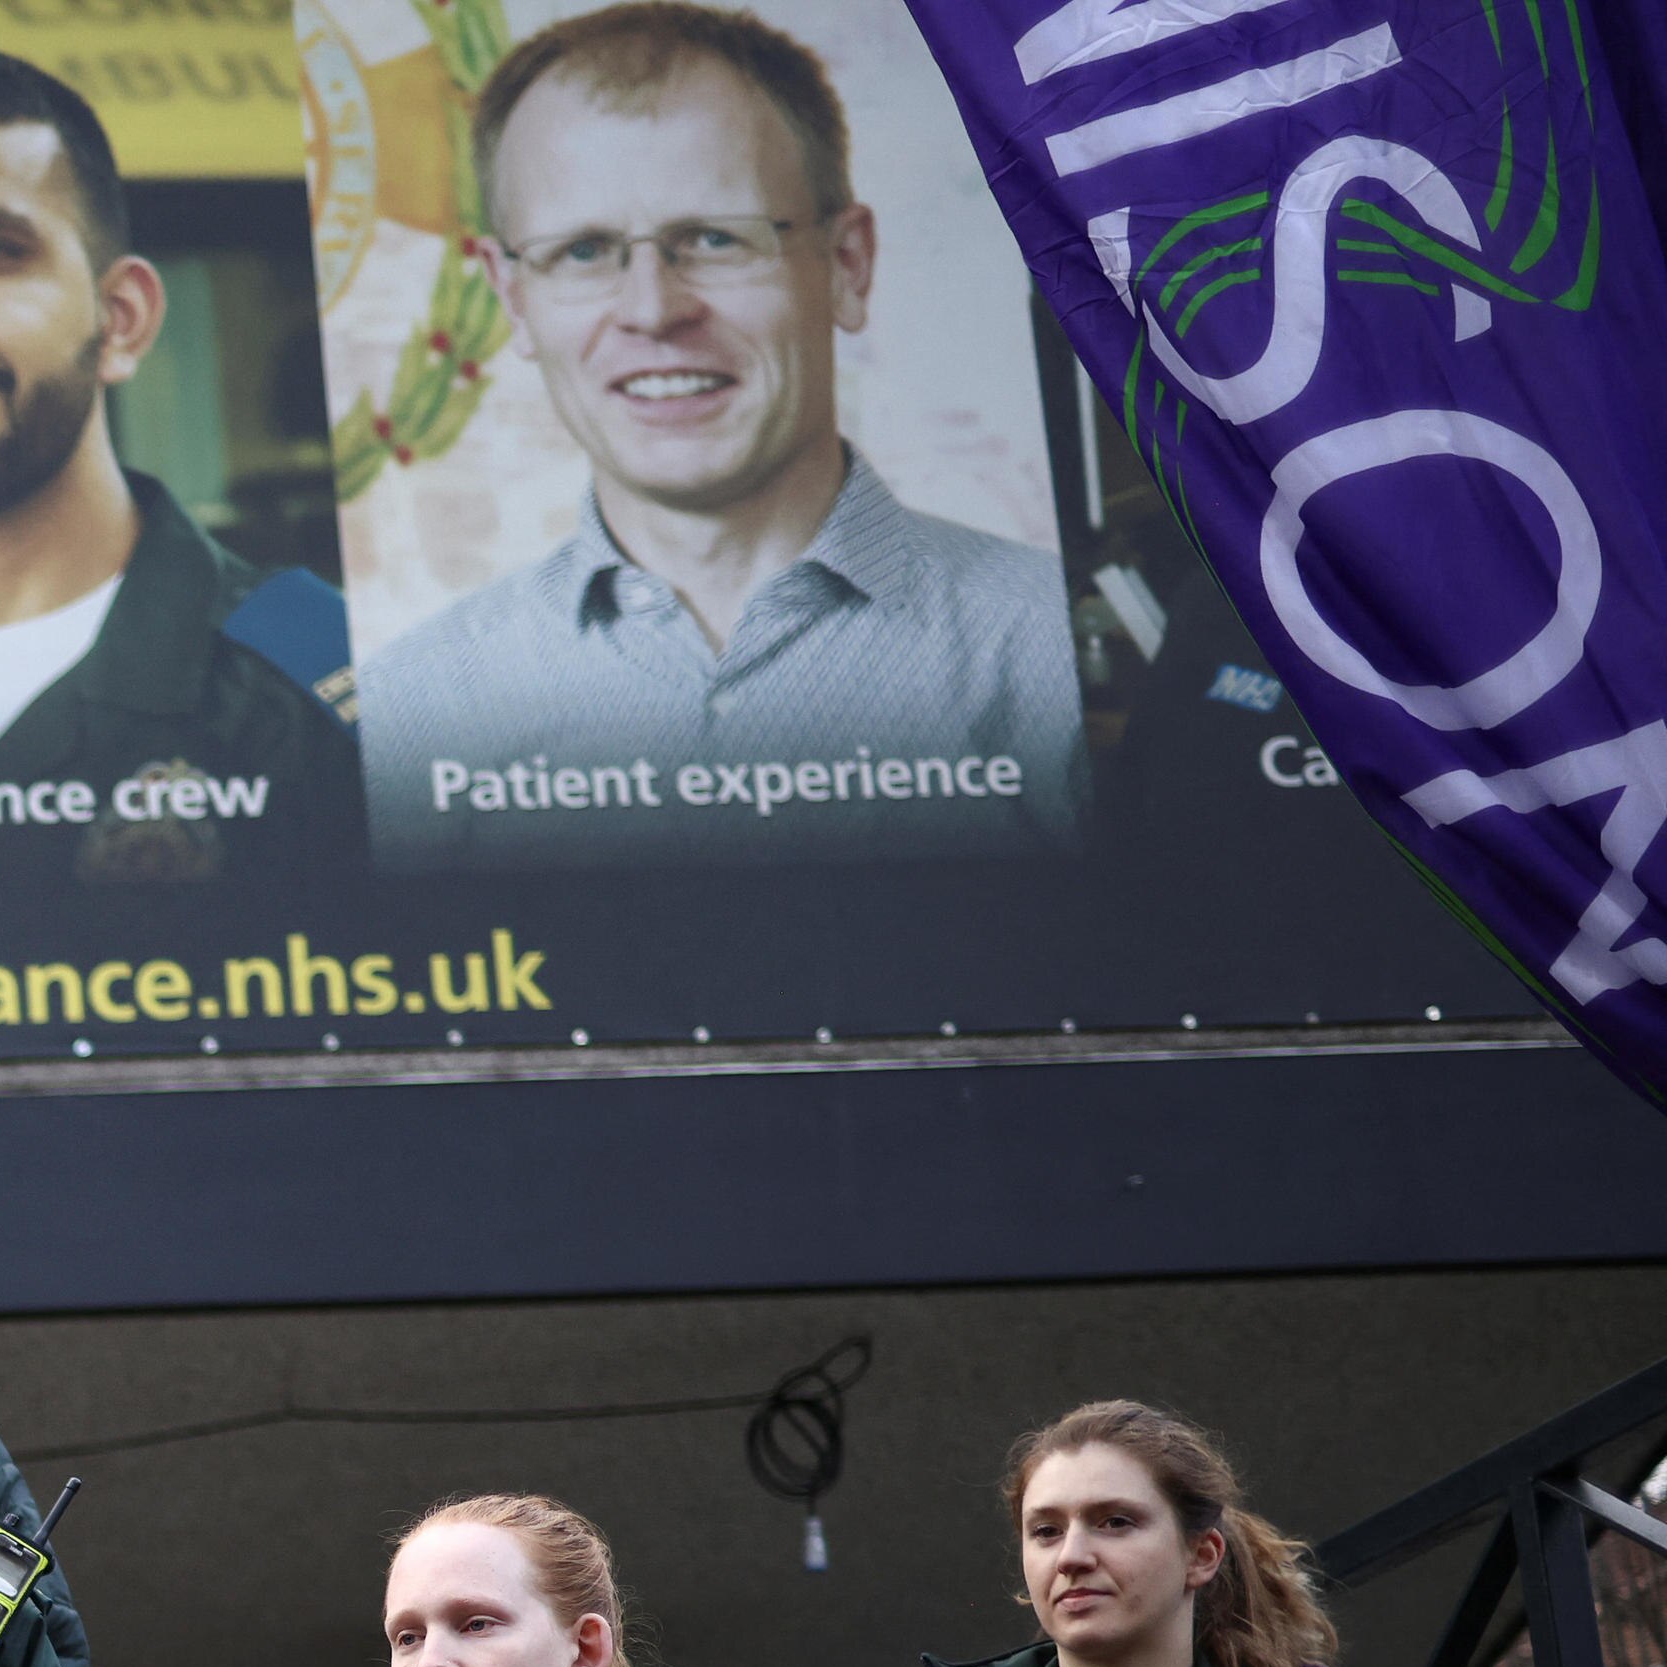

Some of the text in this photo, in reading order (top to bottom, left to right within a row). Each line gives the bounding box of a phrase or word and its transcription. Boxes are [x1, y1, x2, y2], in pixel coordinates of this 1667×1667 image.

[112, 772, 268, 821] crew
[431, 746, 1023, 816] Patient experience
